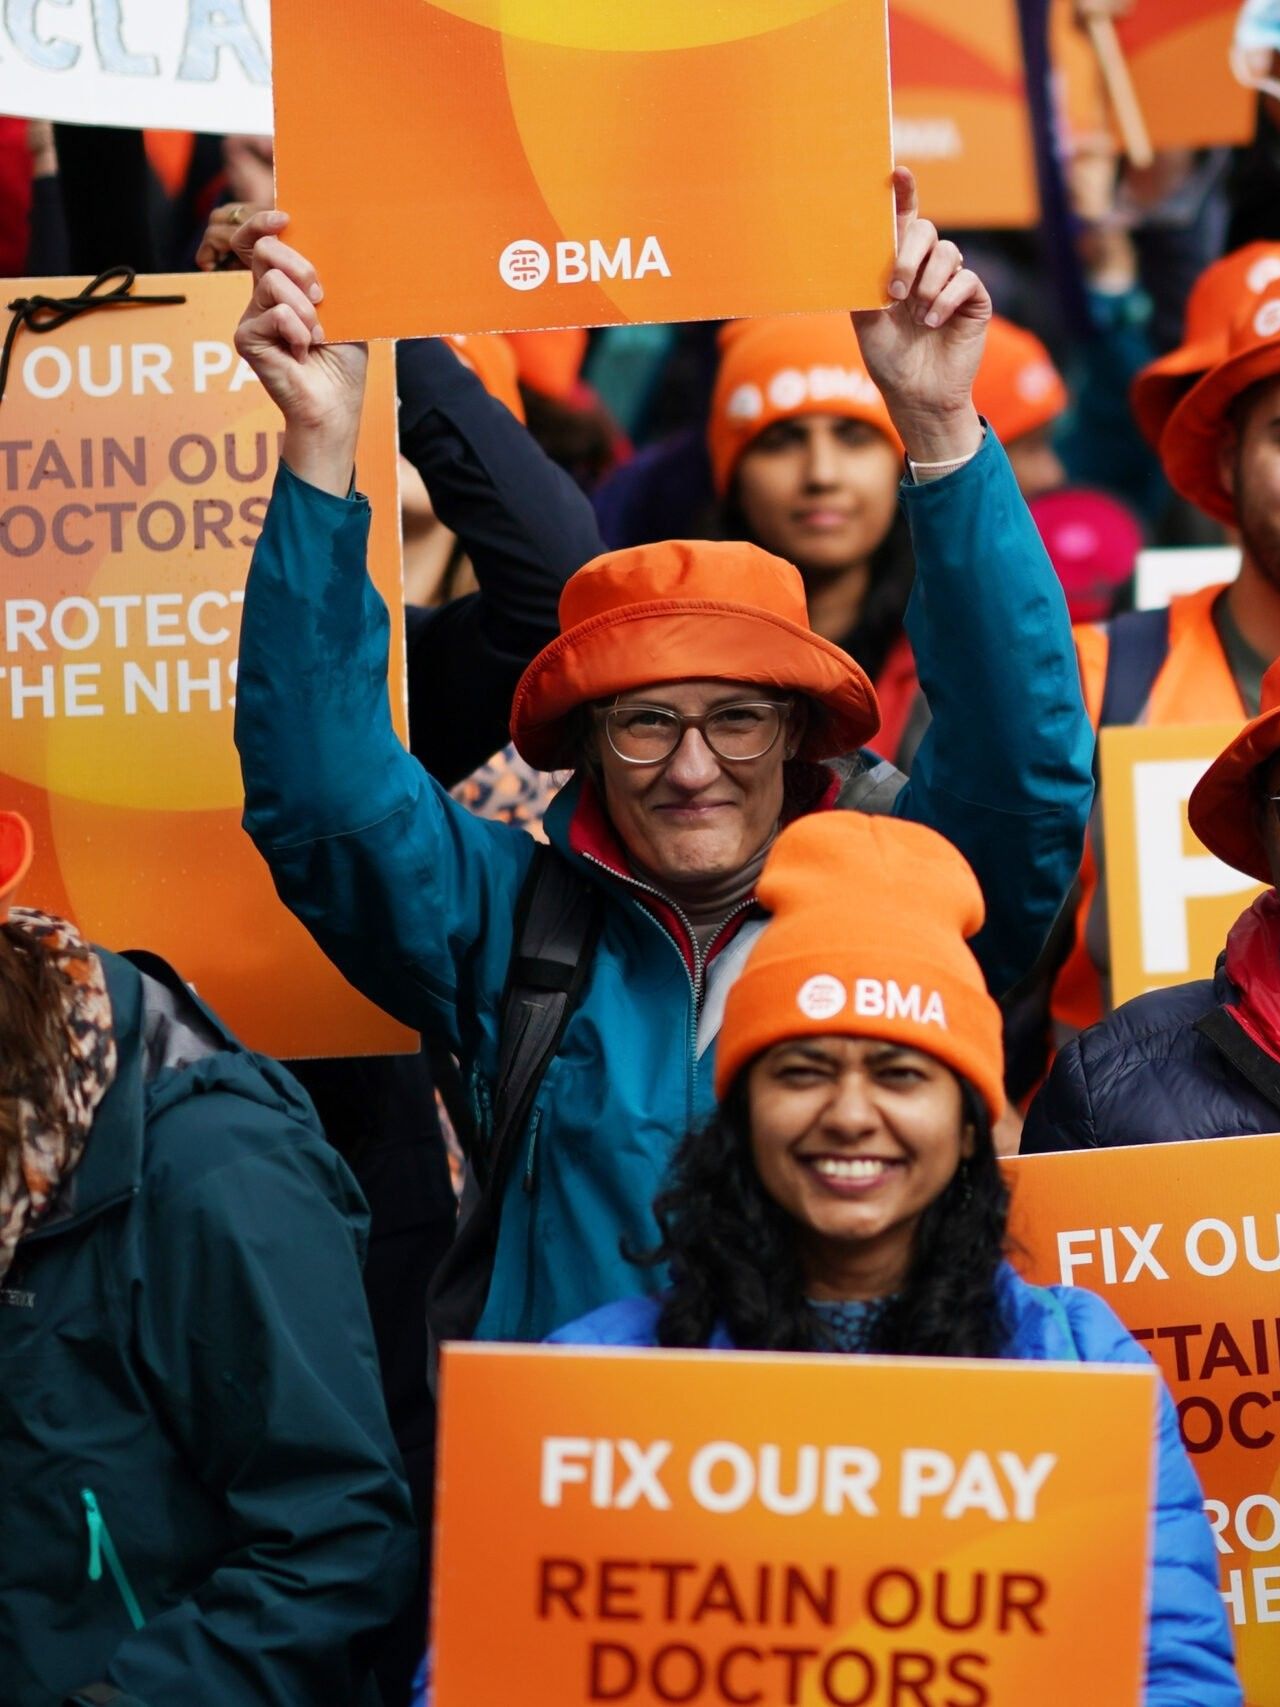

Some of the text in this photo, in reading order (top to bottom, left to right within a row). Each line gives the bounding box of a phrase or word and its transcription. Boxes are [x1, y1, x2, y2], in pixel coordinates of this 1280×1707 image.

[2, 0, 270, 85] CLA
[556, 236, 672, 284] BMA
[22, 343, 173, 399] OUR
[193, 341, 260, 393] PA
[0, 436, 147, 491] TAIN
[0, 497, 270, 557] OCTORS
[0, 588, 245, 652] ROTEC
[855, 979, 947, 1030] BMA
[1056, 1223, 1169, 1287] FIX
[540, 1437, 1057, 1522] FIX OUR PAY
[536, 1555, 1050, 1636] RETAIN OUR
[587, 1640, 992, 1707] DOCTORS
